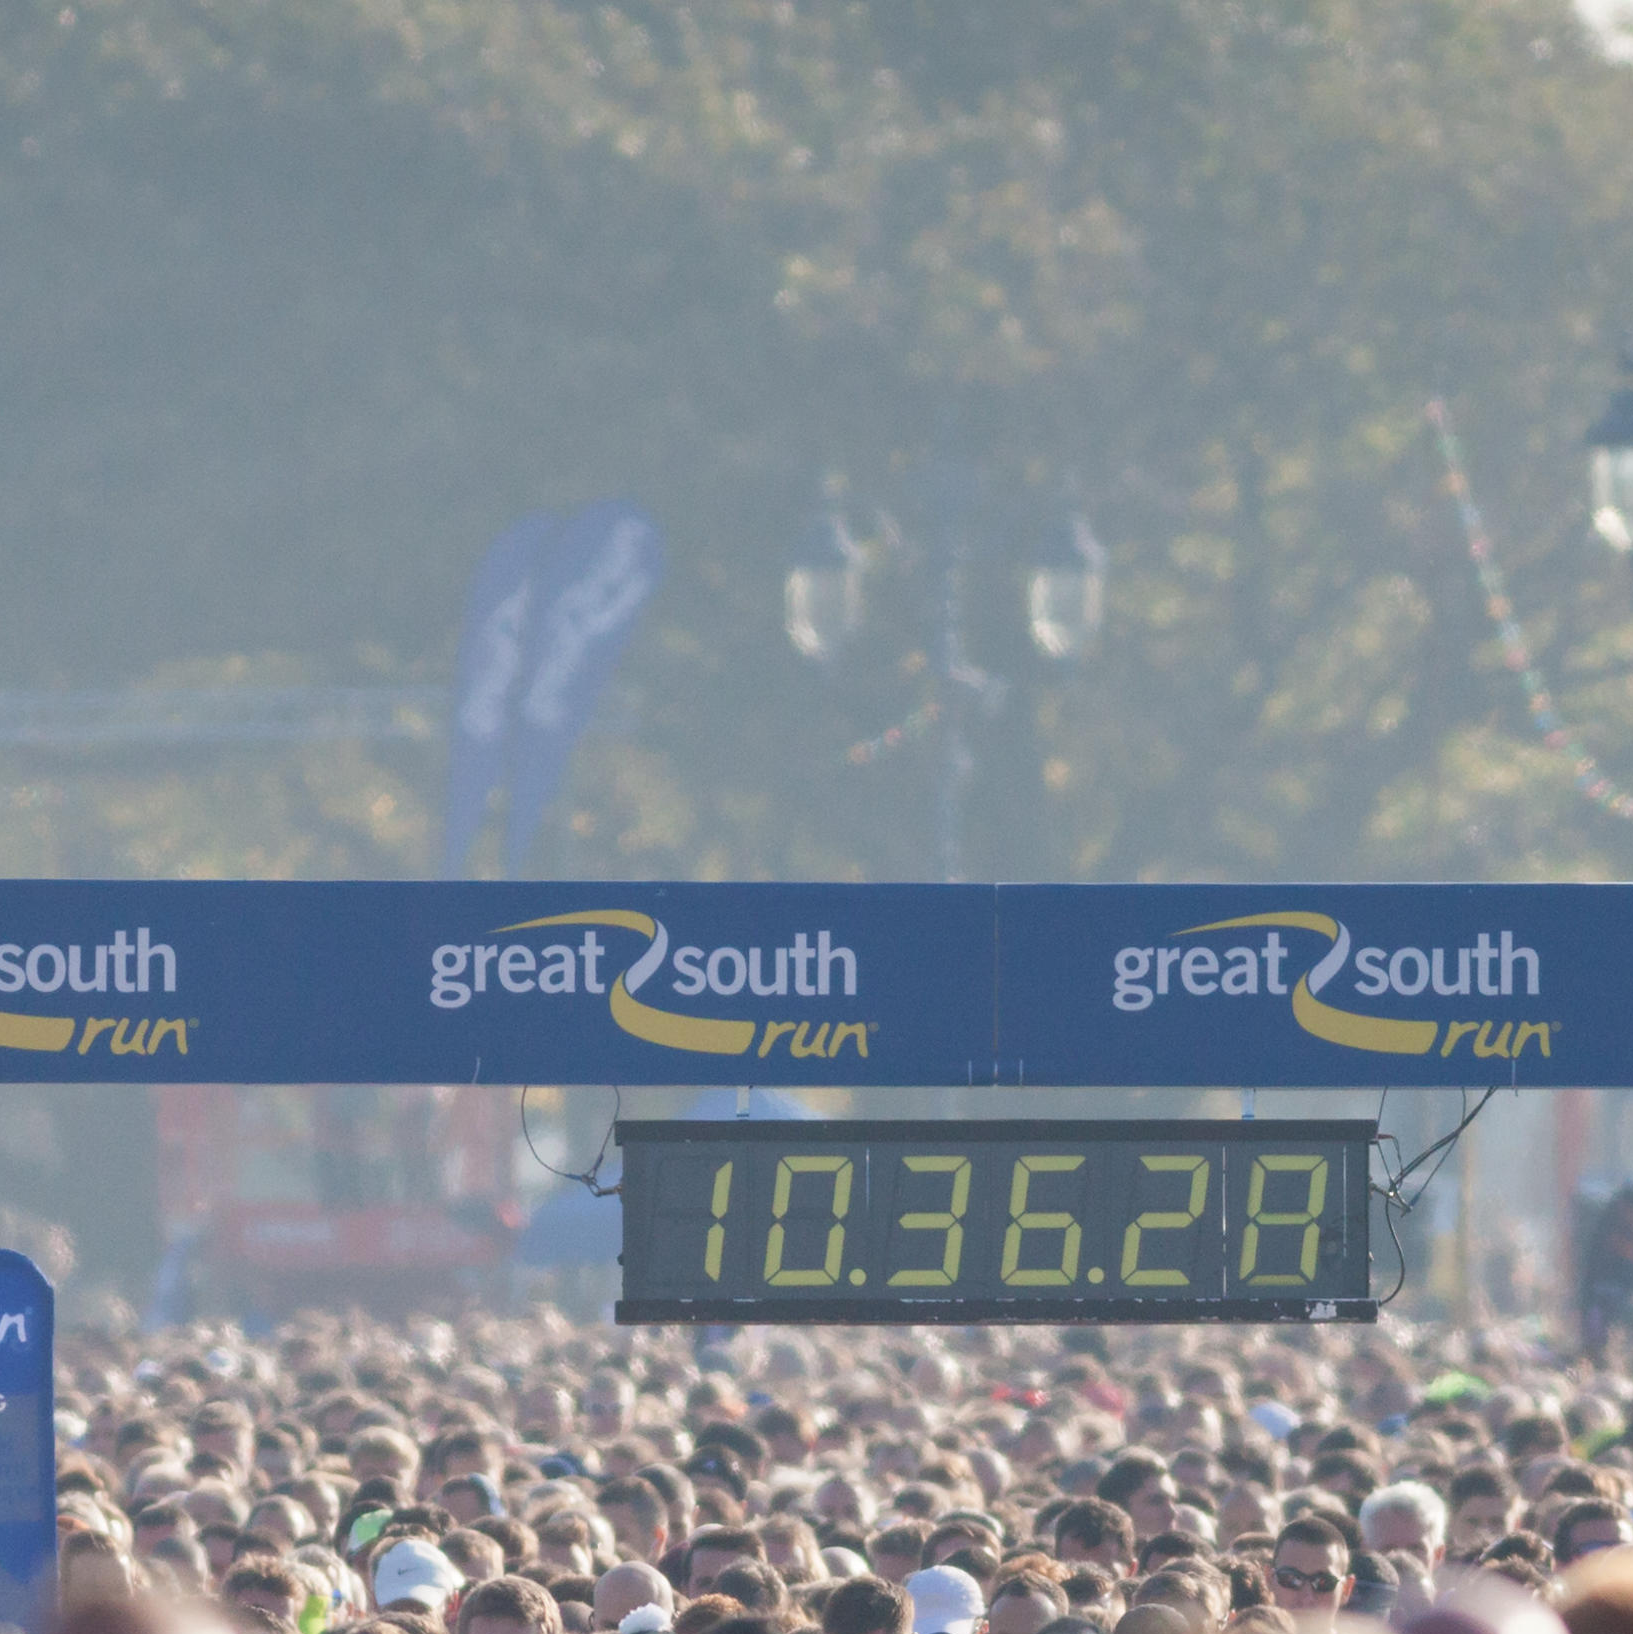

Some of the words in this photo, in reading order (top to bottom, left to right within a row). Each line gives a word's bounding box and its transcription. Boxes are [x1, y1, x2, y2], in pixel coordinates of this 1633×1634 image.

[430, 930, 606, 1009] great
[673, 931, 857, 997] south
[1113, 932, 1288, 1012] great
[1355, 931, 1540, 996] south
[77, 1016, 189, 1056] run
[757, 1020, 869, 1059] run
[1440, 1020, 1551, 1059] run
